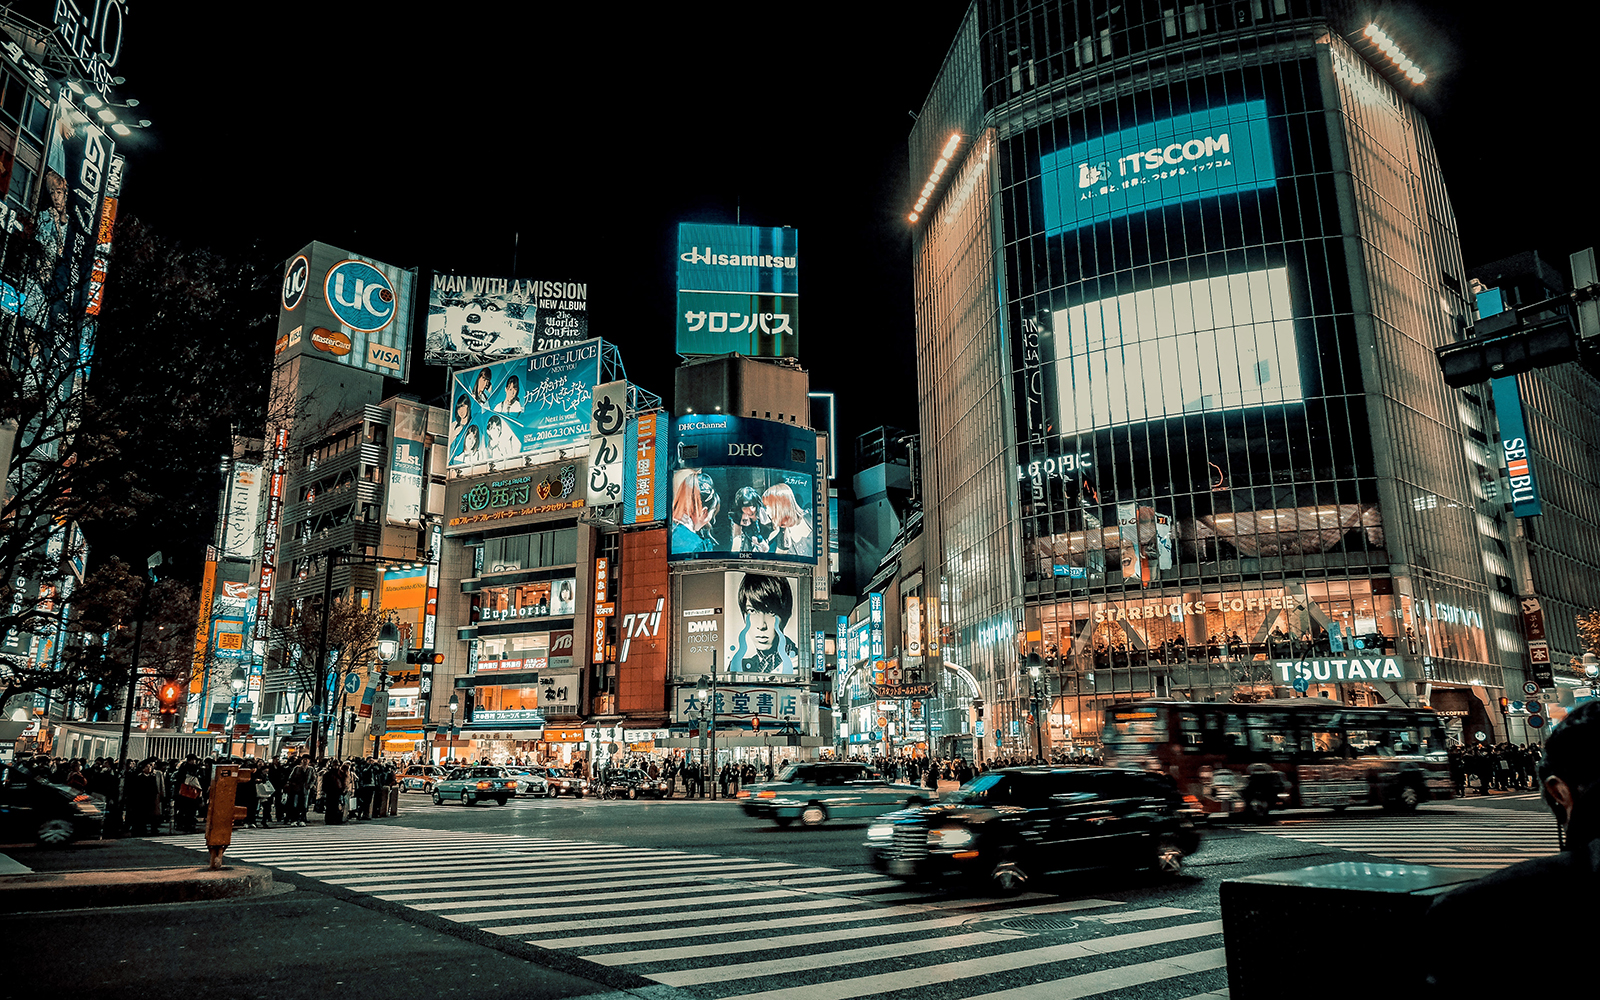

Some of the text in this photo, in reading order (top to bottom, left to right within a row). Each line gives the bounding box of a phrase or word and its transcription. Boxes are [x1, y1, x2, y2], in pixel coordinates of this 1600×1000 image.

[433, 274, 588, 300] MAN WITH A MISSION
[539, 299, 586, 311] NEW ALBUM
[684, 310, 794, 336] サロンパス
[311, 333, 352, 350] MasterCard
[372, 348, 400, 366] VISA
[563, 425, 576, 436] ON
[576, 423, 590, 434] SAL
[678, 421, 727, 432] DHC Channel
[589, 395, 624, 500] もんじゃ
[727, 443, 763, 457] DHC
[635, 418, 652, 516] 三千里薬品
[483, 603, 547, 620] Euphoria
[1095, 595, 1294, 623] STARBUCKS COFFEE
[688, 620, 718, 633] DMM
[551, 634, 572, 652] JTB
[687, 632, 719, 643] mobile
[1276, 658, 1402, 682] TSUTAYA
[683, 692, 797, 715] 大盛堂書店
